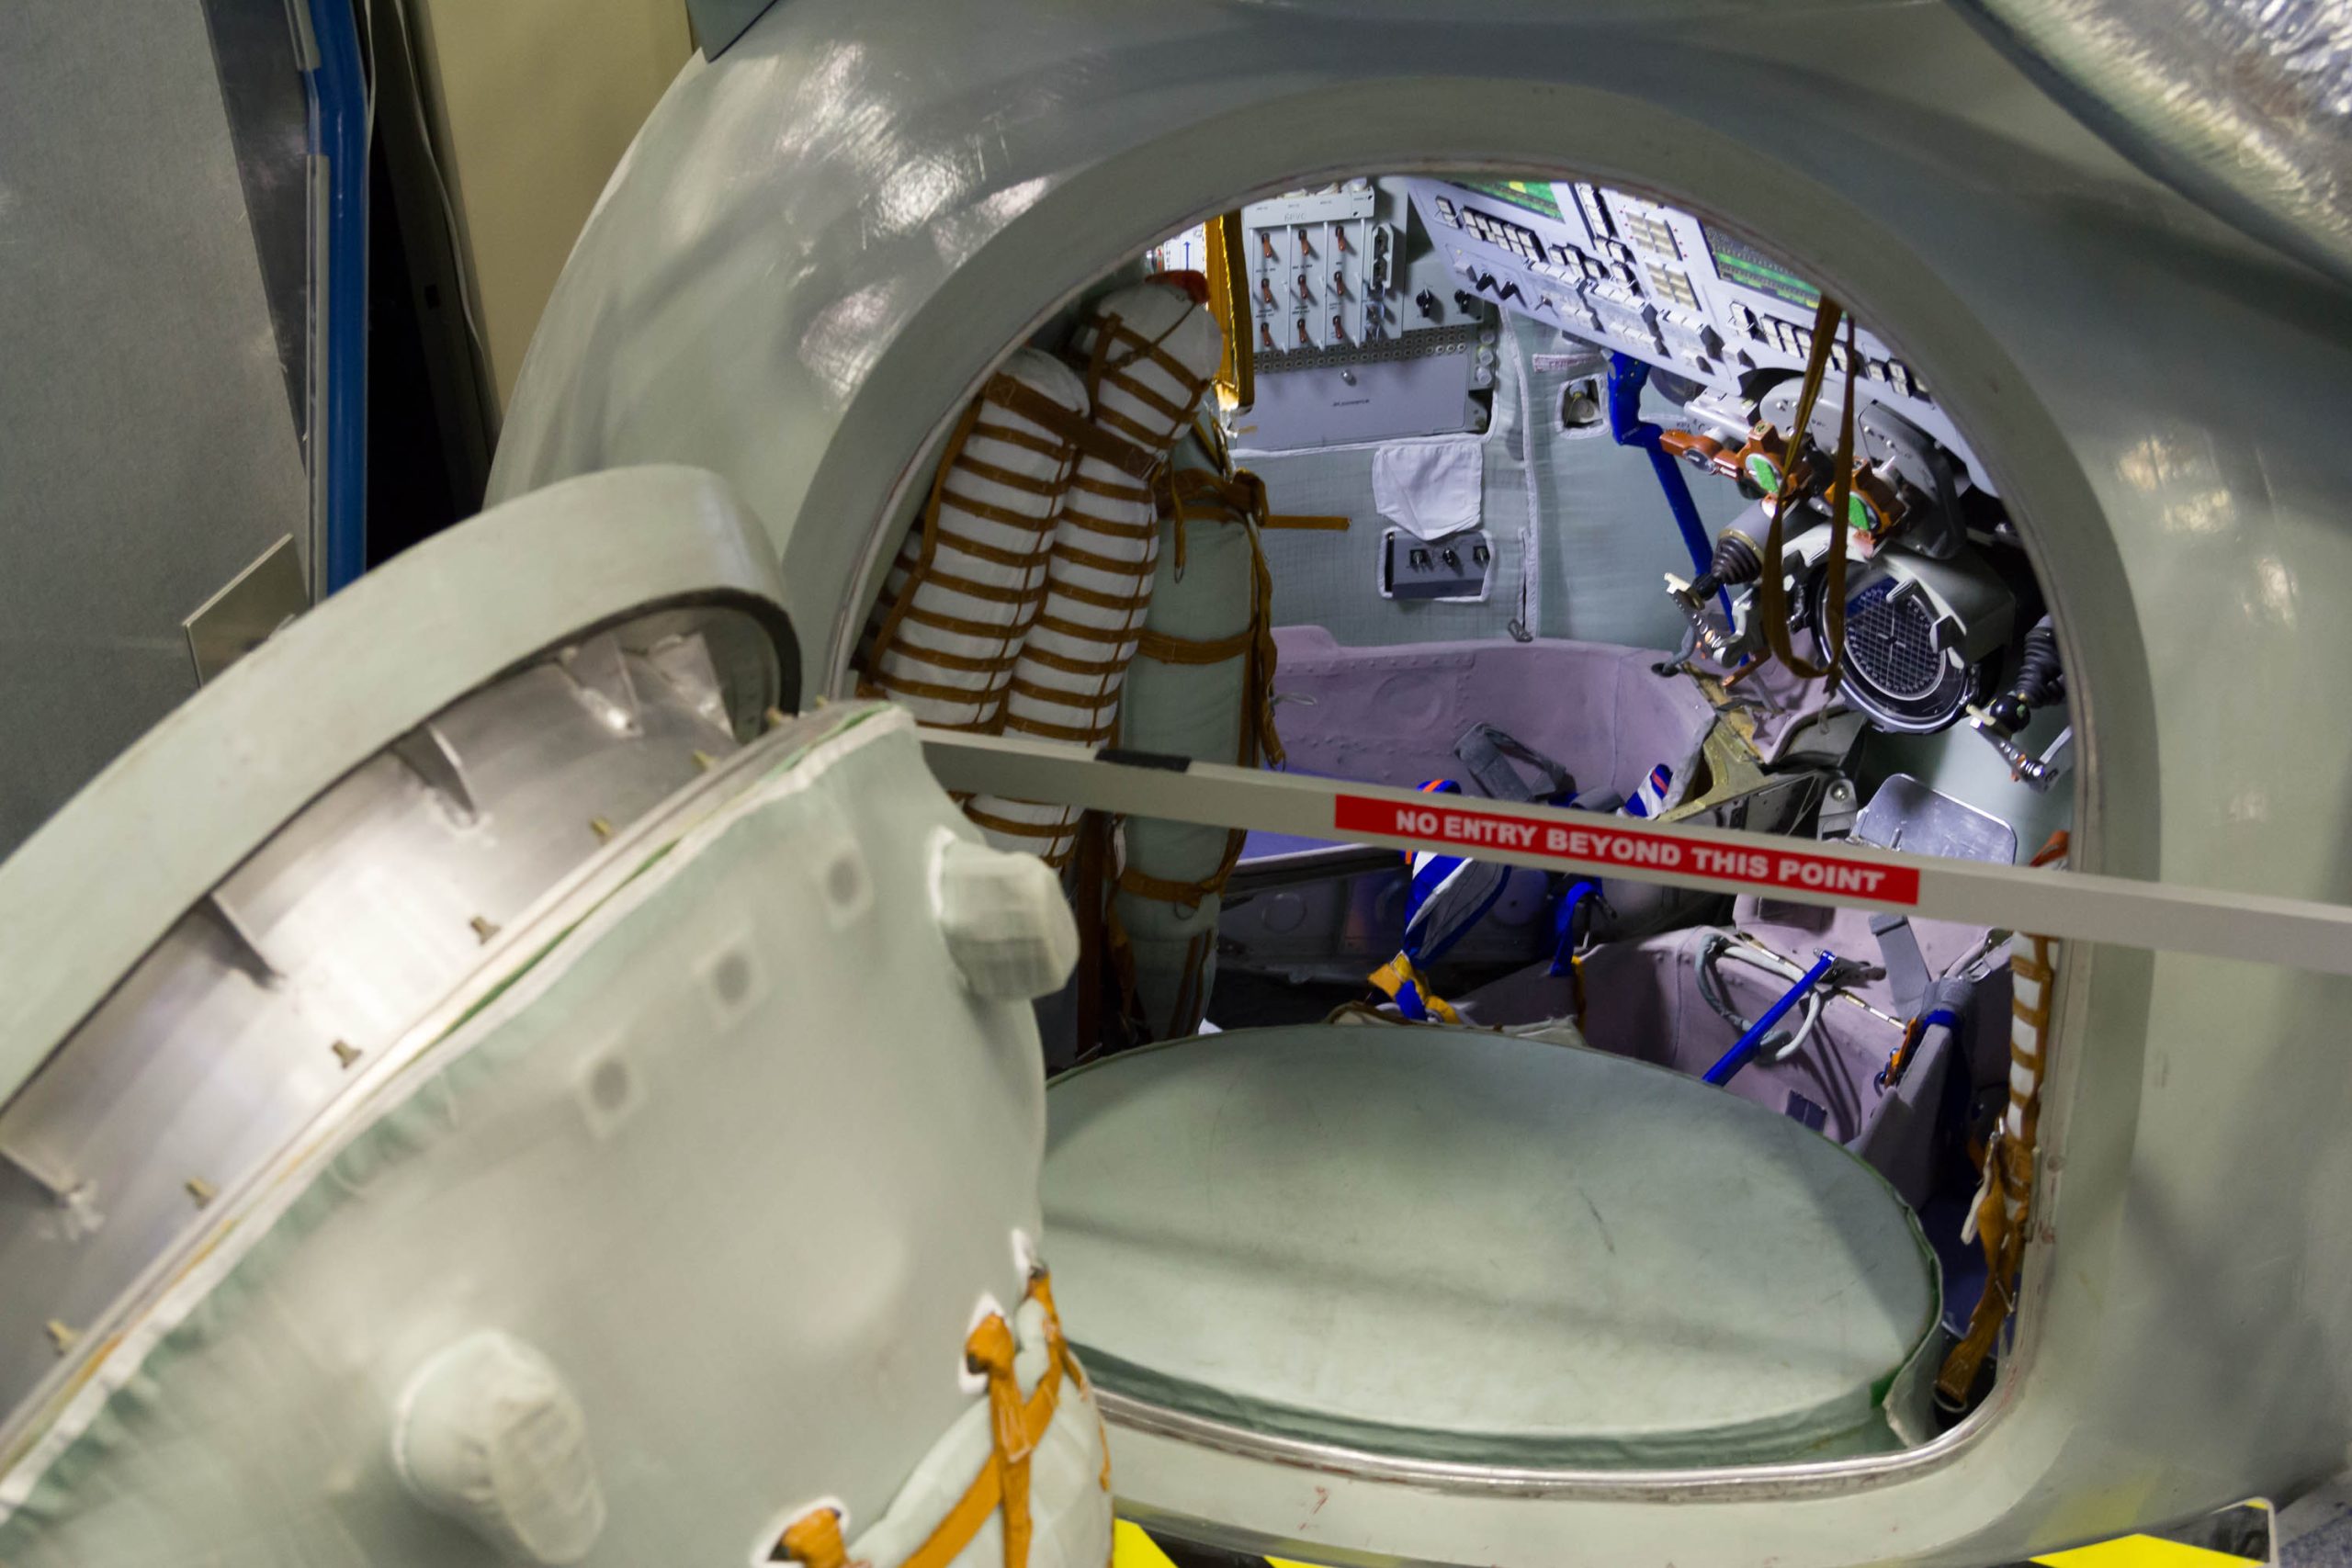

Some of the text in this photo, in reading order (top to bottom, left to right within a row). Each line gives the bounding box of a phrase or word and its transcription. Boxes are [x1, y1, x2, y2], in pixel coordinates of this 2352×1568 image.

[1396, 809, 1885, 892] NO ENTRY BEYOND THIS POINT
